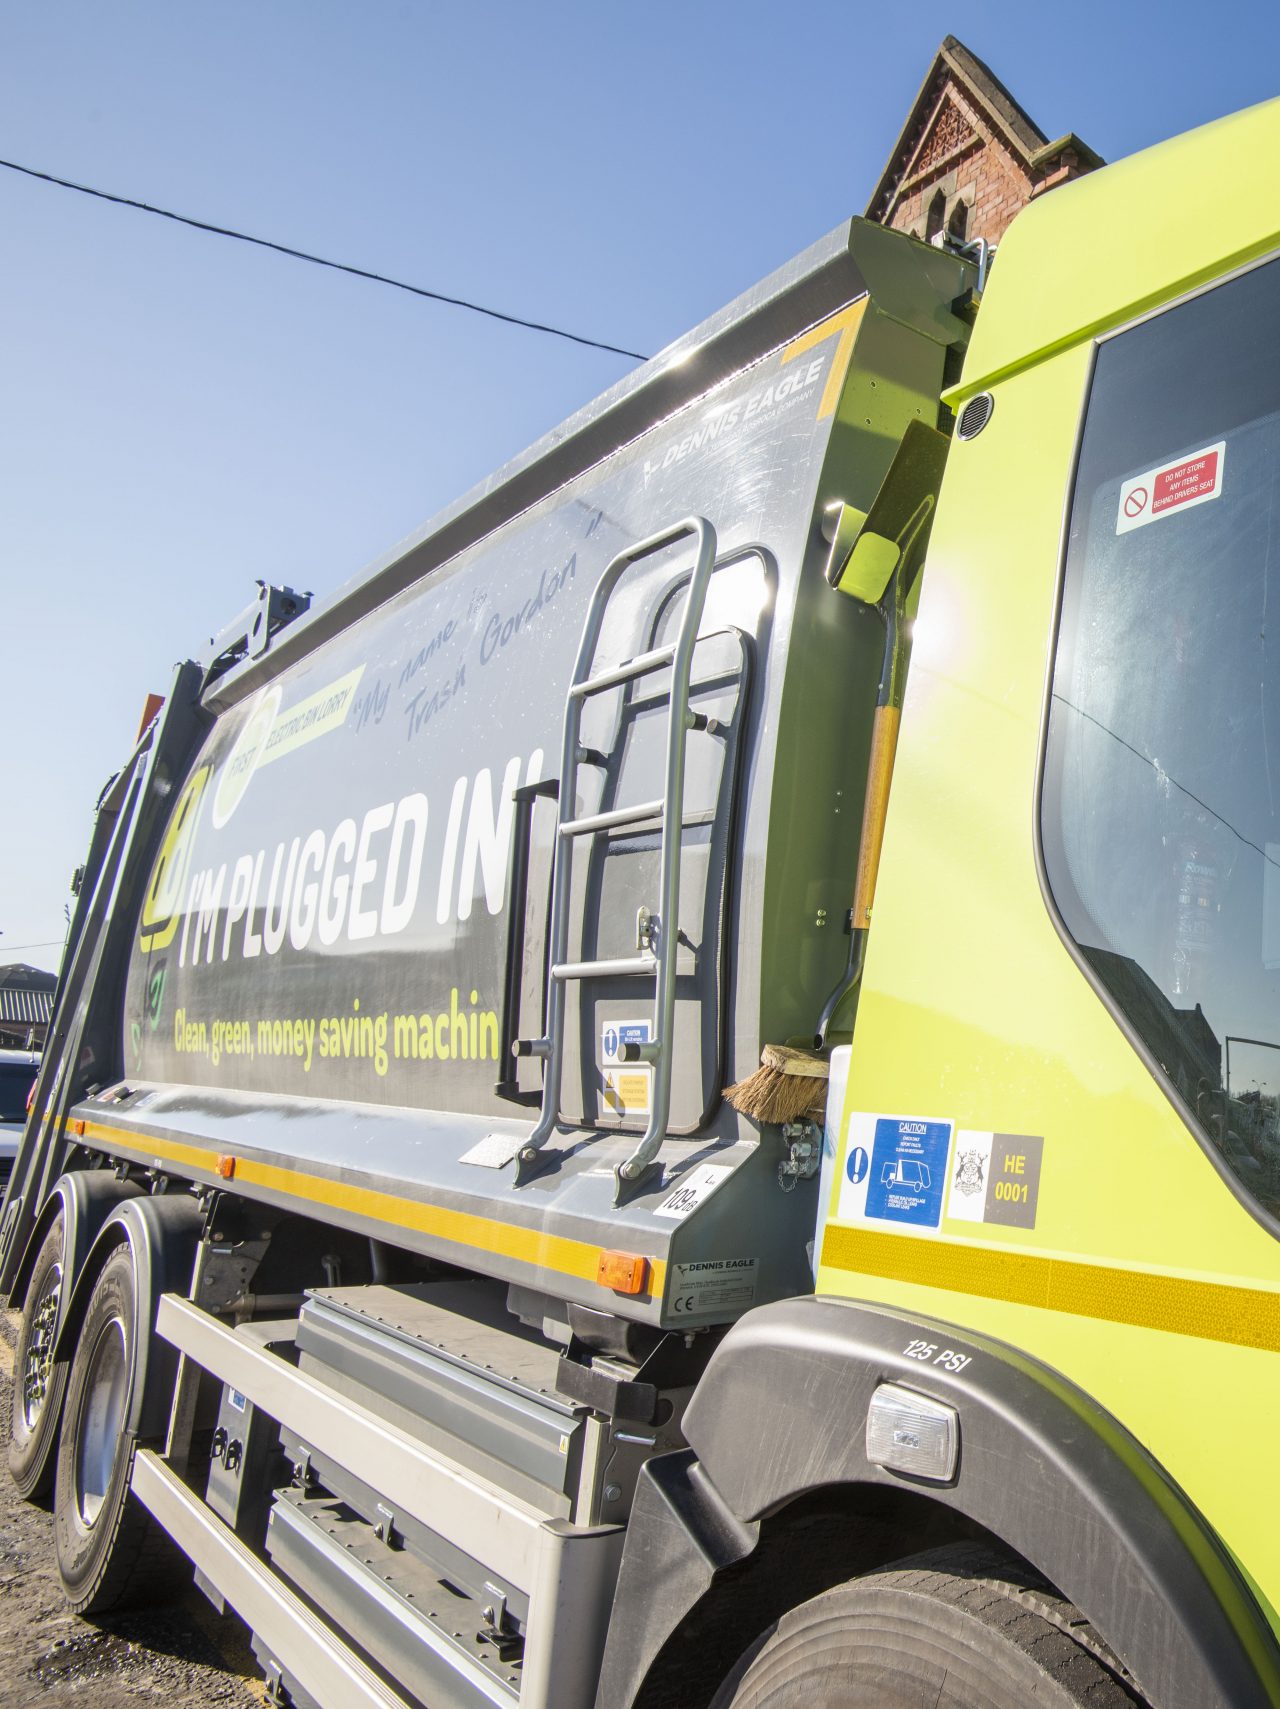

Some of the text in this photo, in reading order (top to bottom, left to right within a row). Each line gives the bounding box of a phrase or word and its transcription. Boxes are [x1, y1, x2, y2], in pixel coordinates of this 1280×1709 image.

[662, 402, 744, 468] DENNIS
[743, 356, 825, 421] EAGLE
[1165, 461, 1206, 483] DO NOT STORE
[1169, 474, 1199, 491] ANY ITEMS
[1153, 494, 1173, 509] BEHIND
[1199, 479, 1214, 491] SEAT
[398, 619, 458, 689] name
[316, 686, 352, 722] LORRY
[404, 663, 467, 742] Trash
[179, 862, 228, 968] I'M
[222, 792, 429, 961] PLUGGED
[174, 987, 499, 1076] Clean, green, money saving machin
[899, 1121, 927, 1134] CAUTION
[1004, 1154, 1026, 1175] HE
[662, 1187, 697, 1211] 109
[994, 1181, 1029, 1204] 0001
[689, 1261, 724, 1272] DENNIS
[725, 1259, 755, 1269] EAGLE
[902, 1339, 973, 1373] 125 PSI
